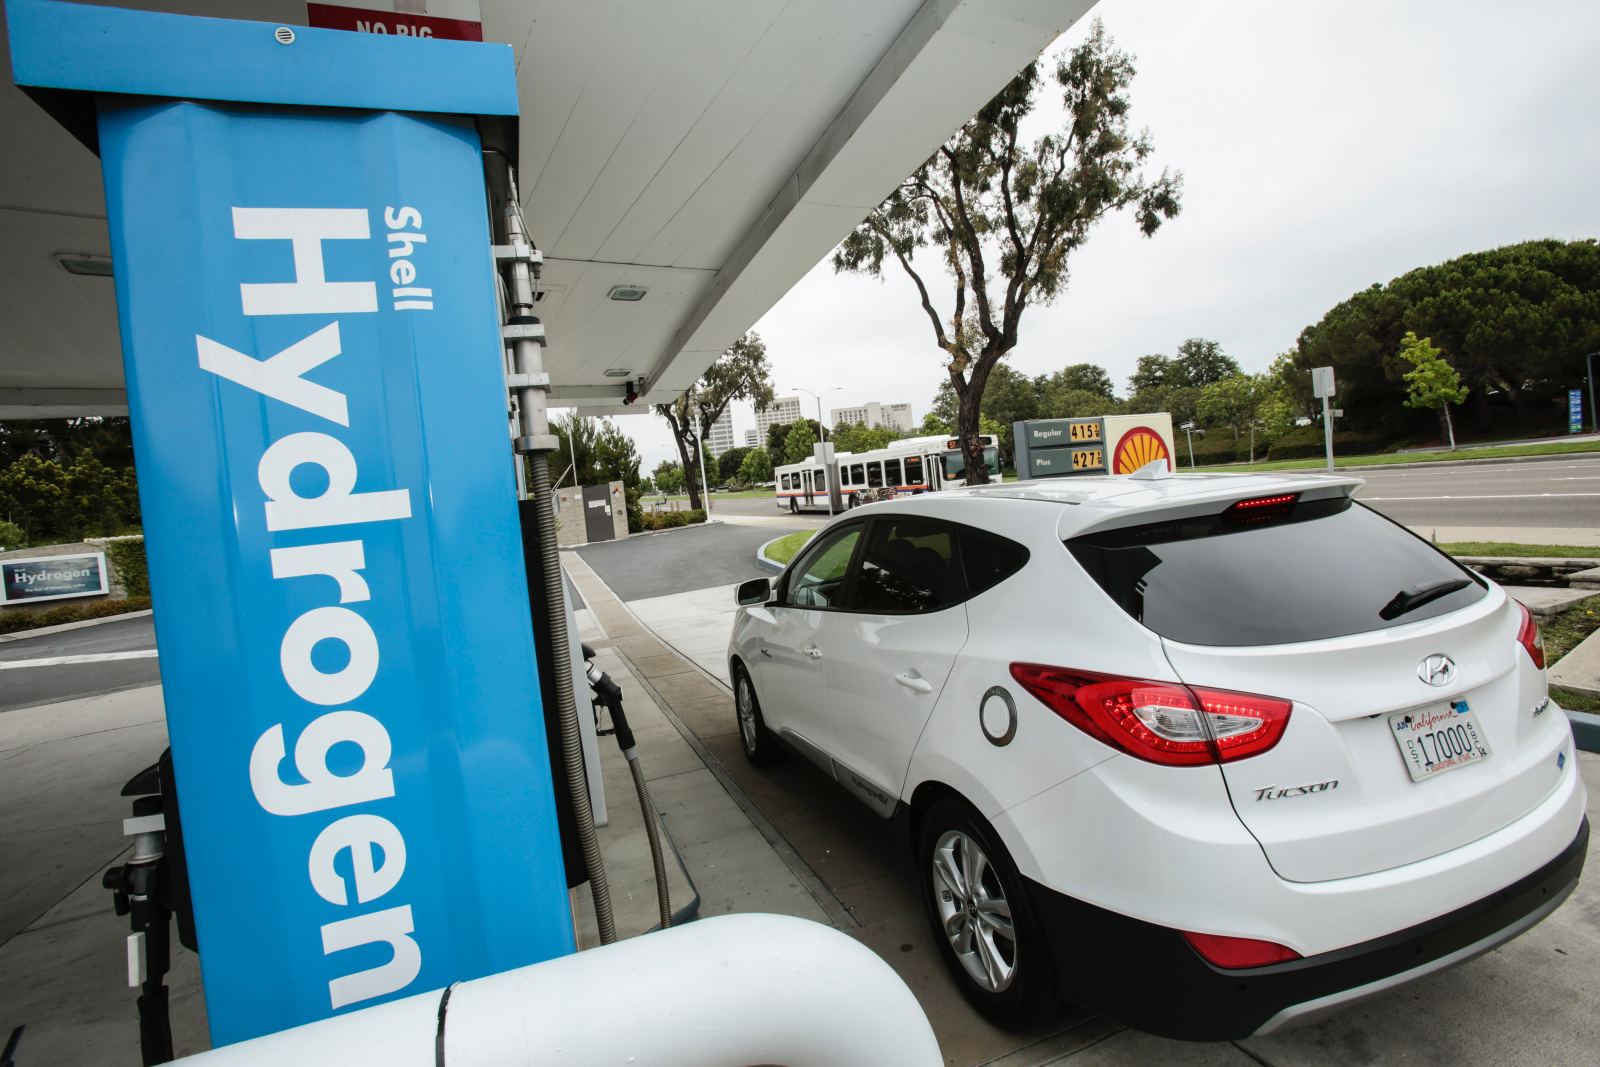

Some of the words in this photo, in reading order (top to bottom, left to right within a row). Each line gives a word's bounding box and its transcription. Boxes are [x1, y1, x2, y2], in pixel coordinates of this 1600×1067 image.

[356, 20, 388, 35] NO
[385, 206, 434, 311] Shell
[1033, 429, 1062, 439] Regular
[1036, 458, 1051, 467] Plus
[15, 569, 91, 585] Hydrogen
[196, 206, 422, 1010] Hydrogen
[1409, 710, 1459, 732] California
[1417, 724, 1472, 767] 17000
[1253, 780, 1339, 802] Tucson
